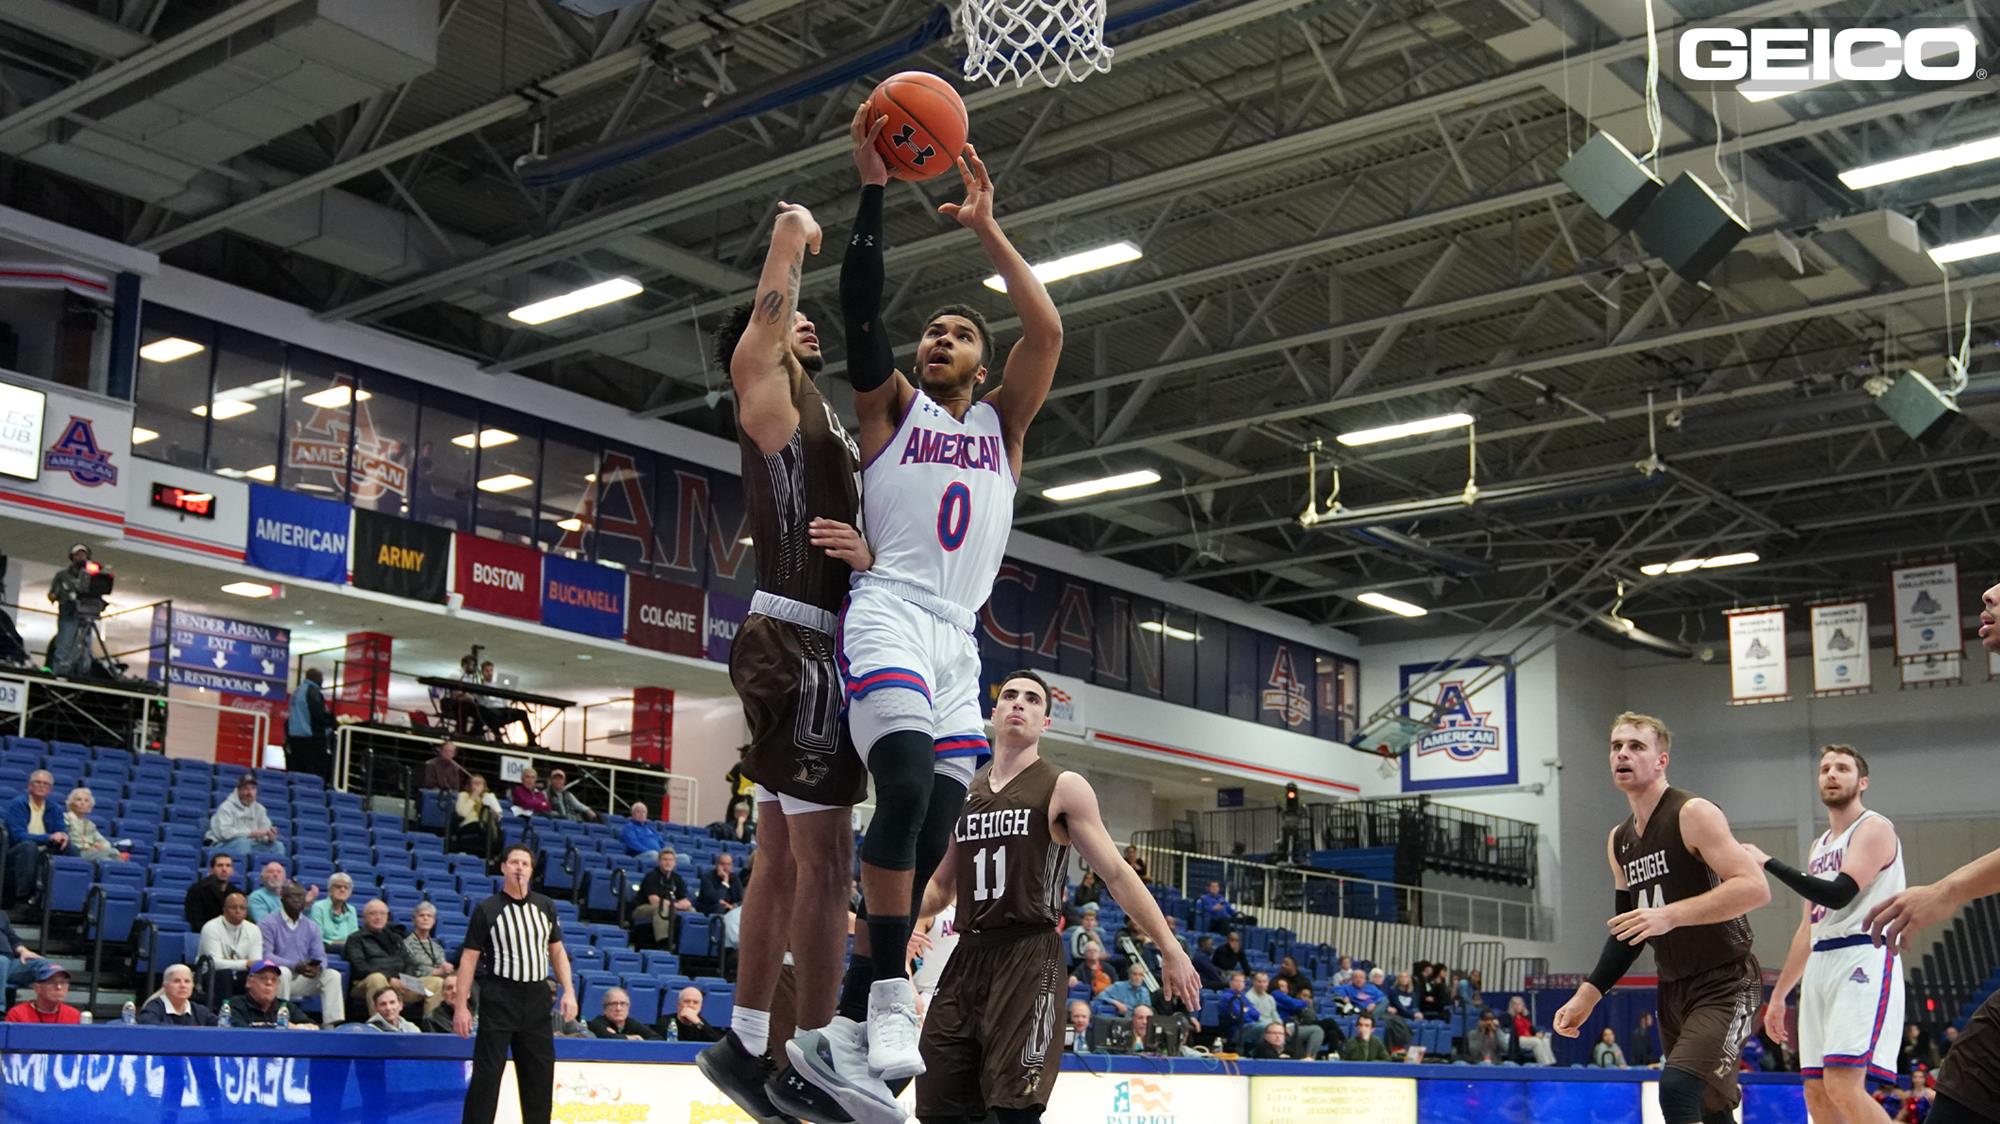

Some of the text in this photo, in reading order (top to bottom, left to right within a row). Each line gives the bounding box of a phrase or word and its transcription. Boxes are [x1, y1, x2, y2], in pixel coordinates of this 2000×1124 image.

[899, 426, 1001, 475] AMERCAN
[937, 480, 971, 552] 0
[255, 517, 345, 554] AMERICAN
[377, 544, 425, 572] ARMY
[472, 562, 524, 593] BOSTON
[548, 581, 620, 614] BUCKNELL
[175, 610, 271, 642] BENDER ARENA
[639, 603, 697, 634] COLGATE
[709, 617, 740, 641] HOLY
[208, 635, 236, 652] EXIT
[0, 686, 16, 703] 03
[184, 670, 253, 692] RESTROOMS
[1423, 730, 1494, 749] AMERICAN
[954, 808, 1031, 843] LEHIGH
[973, 845, 1006, 901] 11
[1623, 849, 1670, 887] LEHIGH
